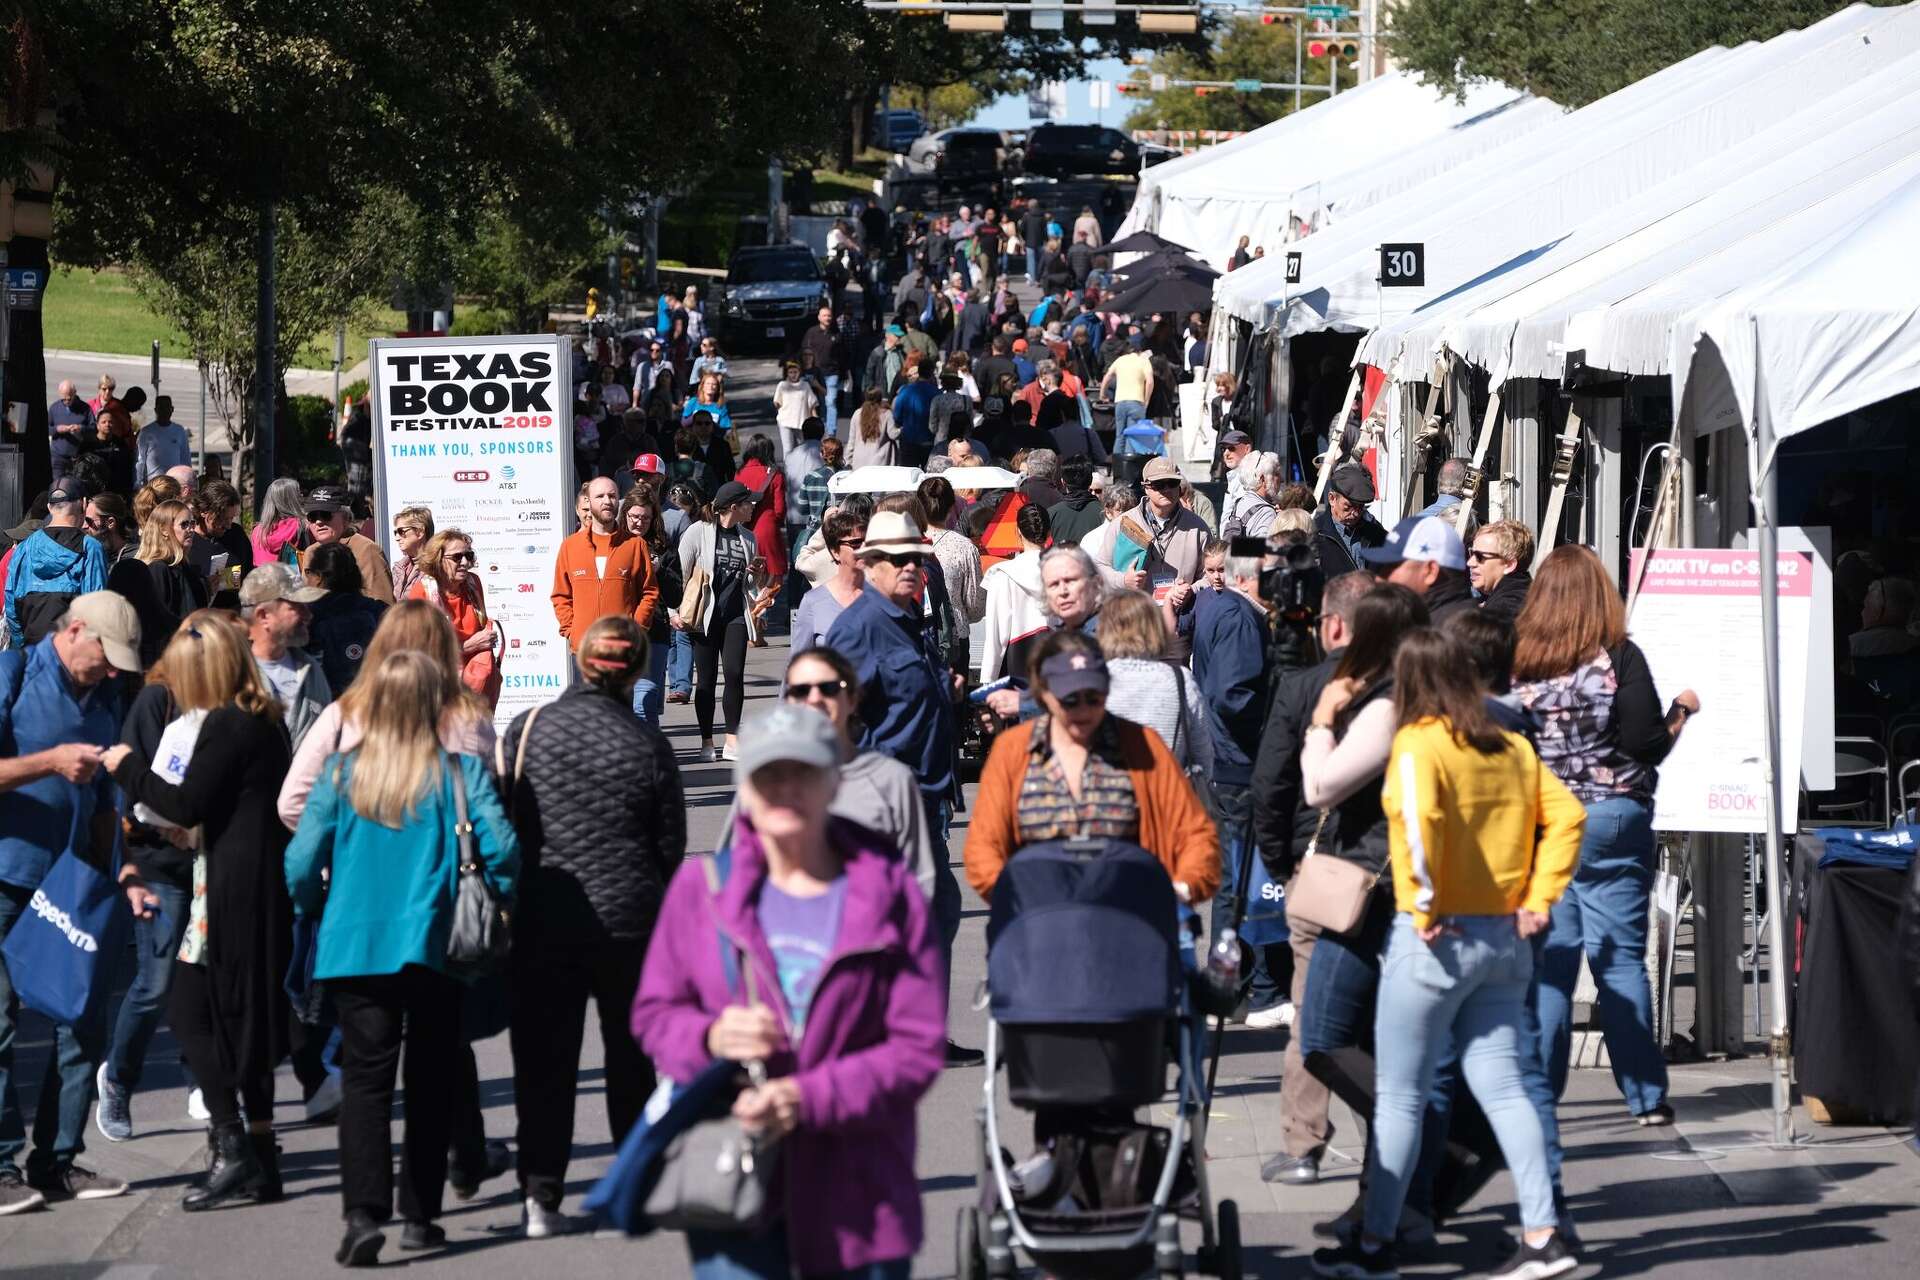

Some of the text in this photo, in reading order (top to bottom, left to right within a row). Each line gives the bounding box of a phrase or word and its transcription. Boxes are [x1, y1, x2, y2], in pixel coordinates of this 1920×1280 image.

[1287, 257, 1299, 278] 27
[1387, 250, 1417, 278] 30
[387, 351, 552, 382] TEXAS
[389, 381, 553, 416] BOOK
[391, 441, 553, 458] THANK YOU, SPONSORS
[499, 482, 517, 490] AT&T
[1687, 559, 1710, 575] TV
[518, 583, 535, 593] 3M
[505, 674, 560, 688] ESTIVAL
[1707, 793, 1758, 810] BOOK
